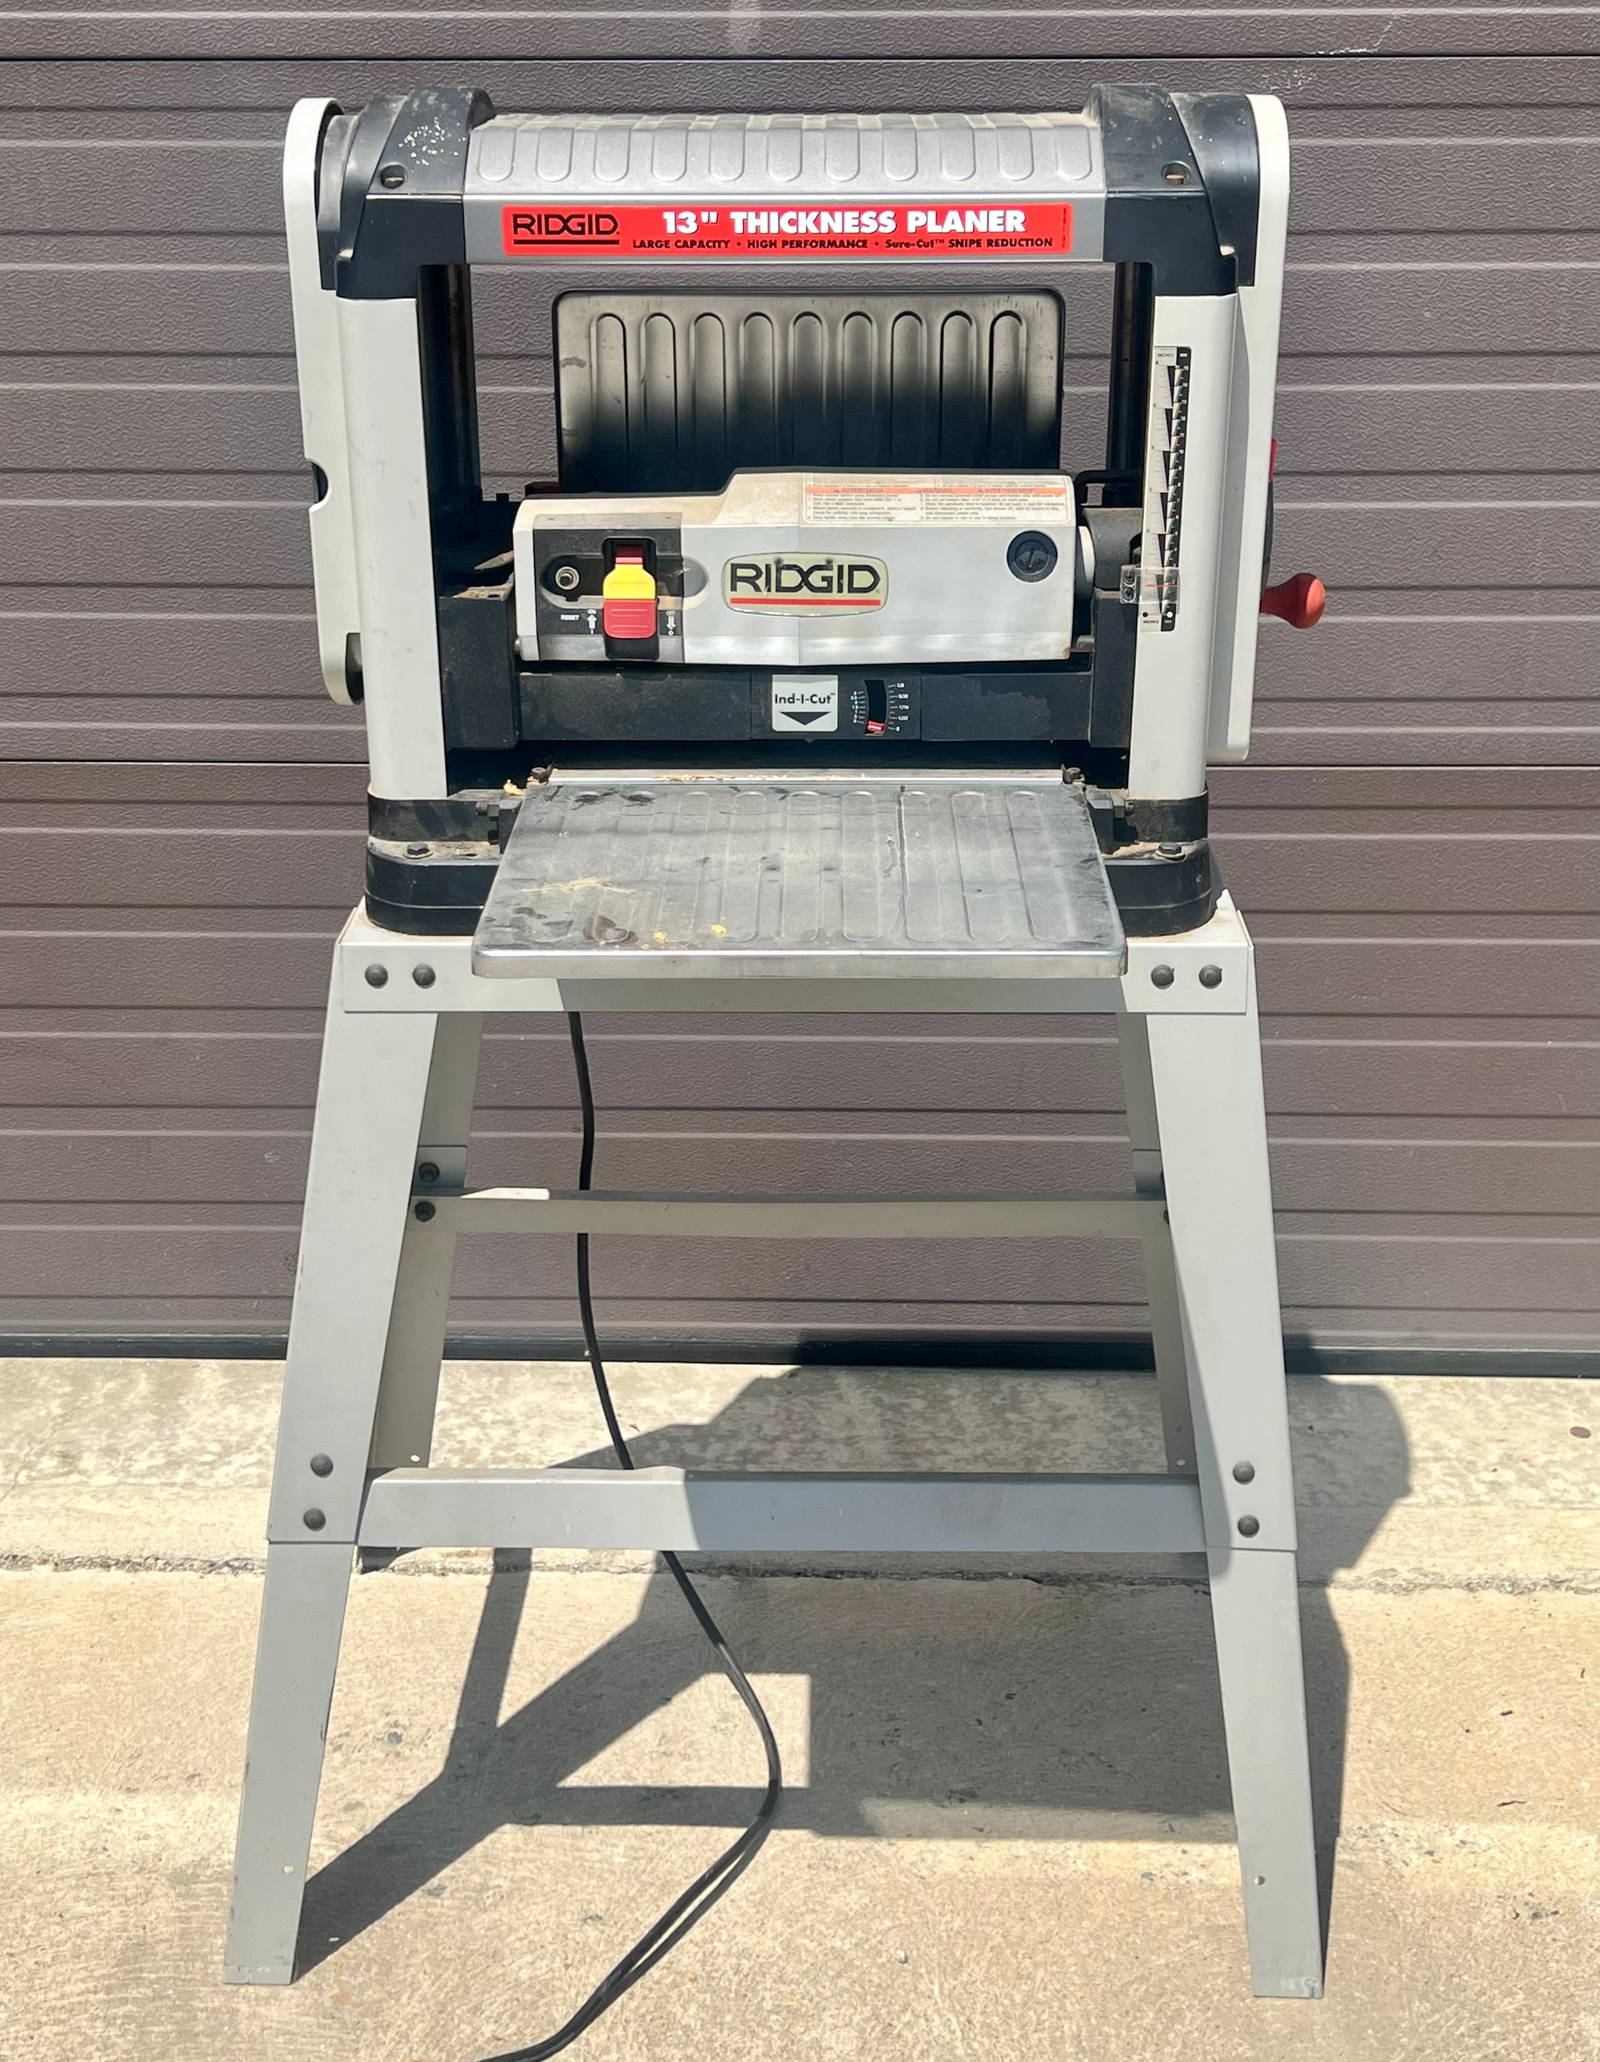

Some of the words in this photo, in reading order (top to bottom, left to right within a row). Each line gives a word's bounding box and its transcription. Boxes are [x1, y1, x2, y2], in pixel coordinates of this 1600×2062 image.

[513, 213, 620, 235] RIDGID
[663, 210, 719, 234] 13"
[729, 210, 897, 235] THICKNESS
[906, 209, 1027, 234] PLANER
[632, 239, 672, 249] LARGE
[674, 239, 731, 249] CAPACITY
[747, 239, 778, 249] HIGH
[781, 239, 868, 249] PERFORMANCE
[947, 238, 982, 248] SNIPE
[986, 237, 1054, 248] REDUCTION
[730, 563, 881, 594] RIDGID
[560, 613, 580, 621] RESET
